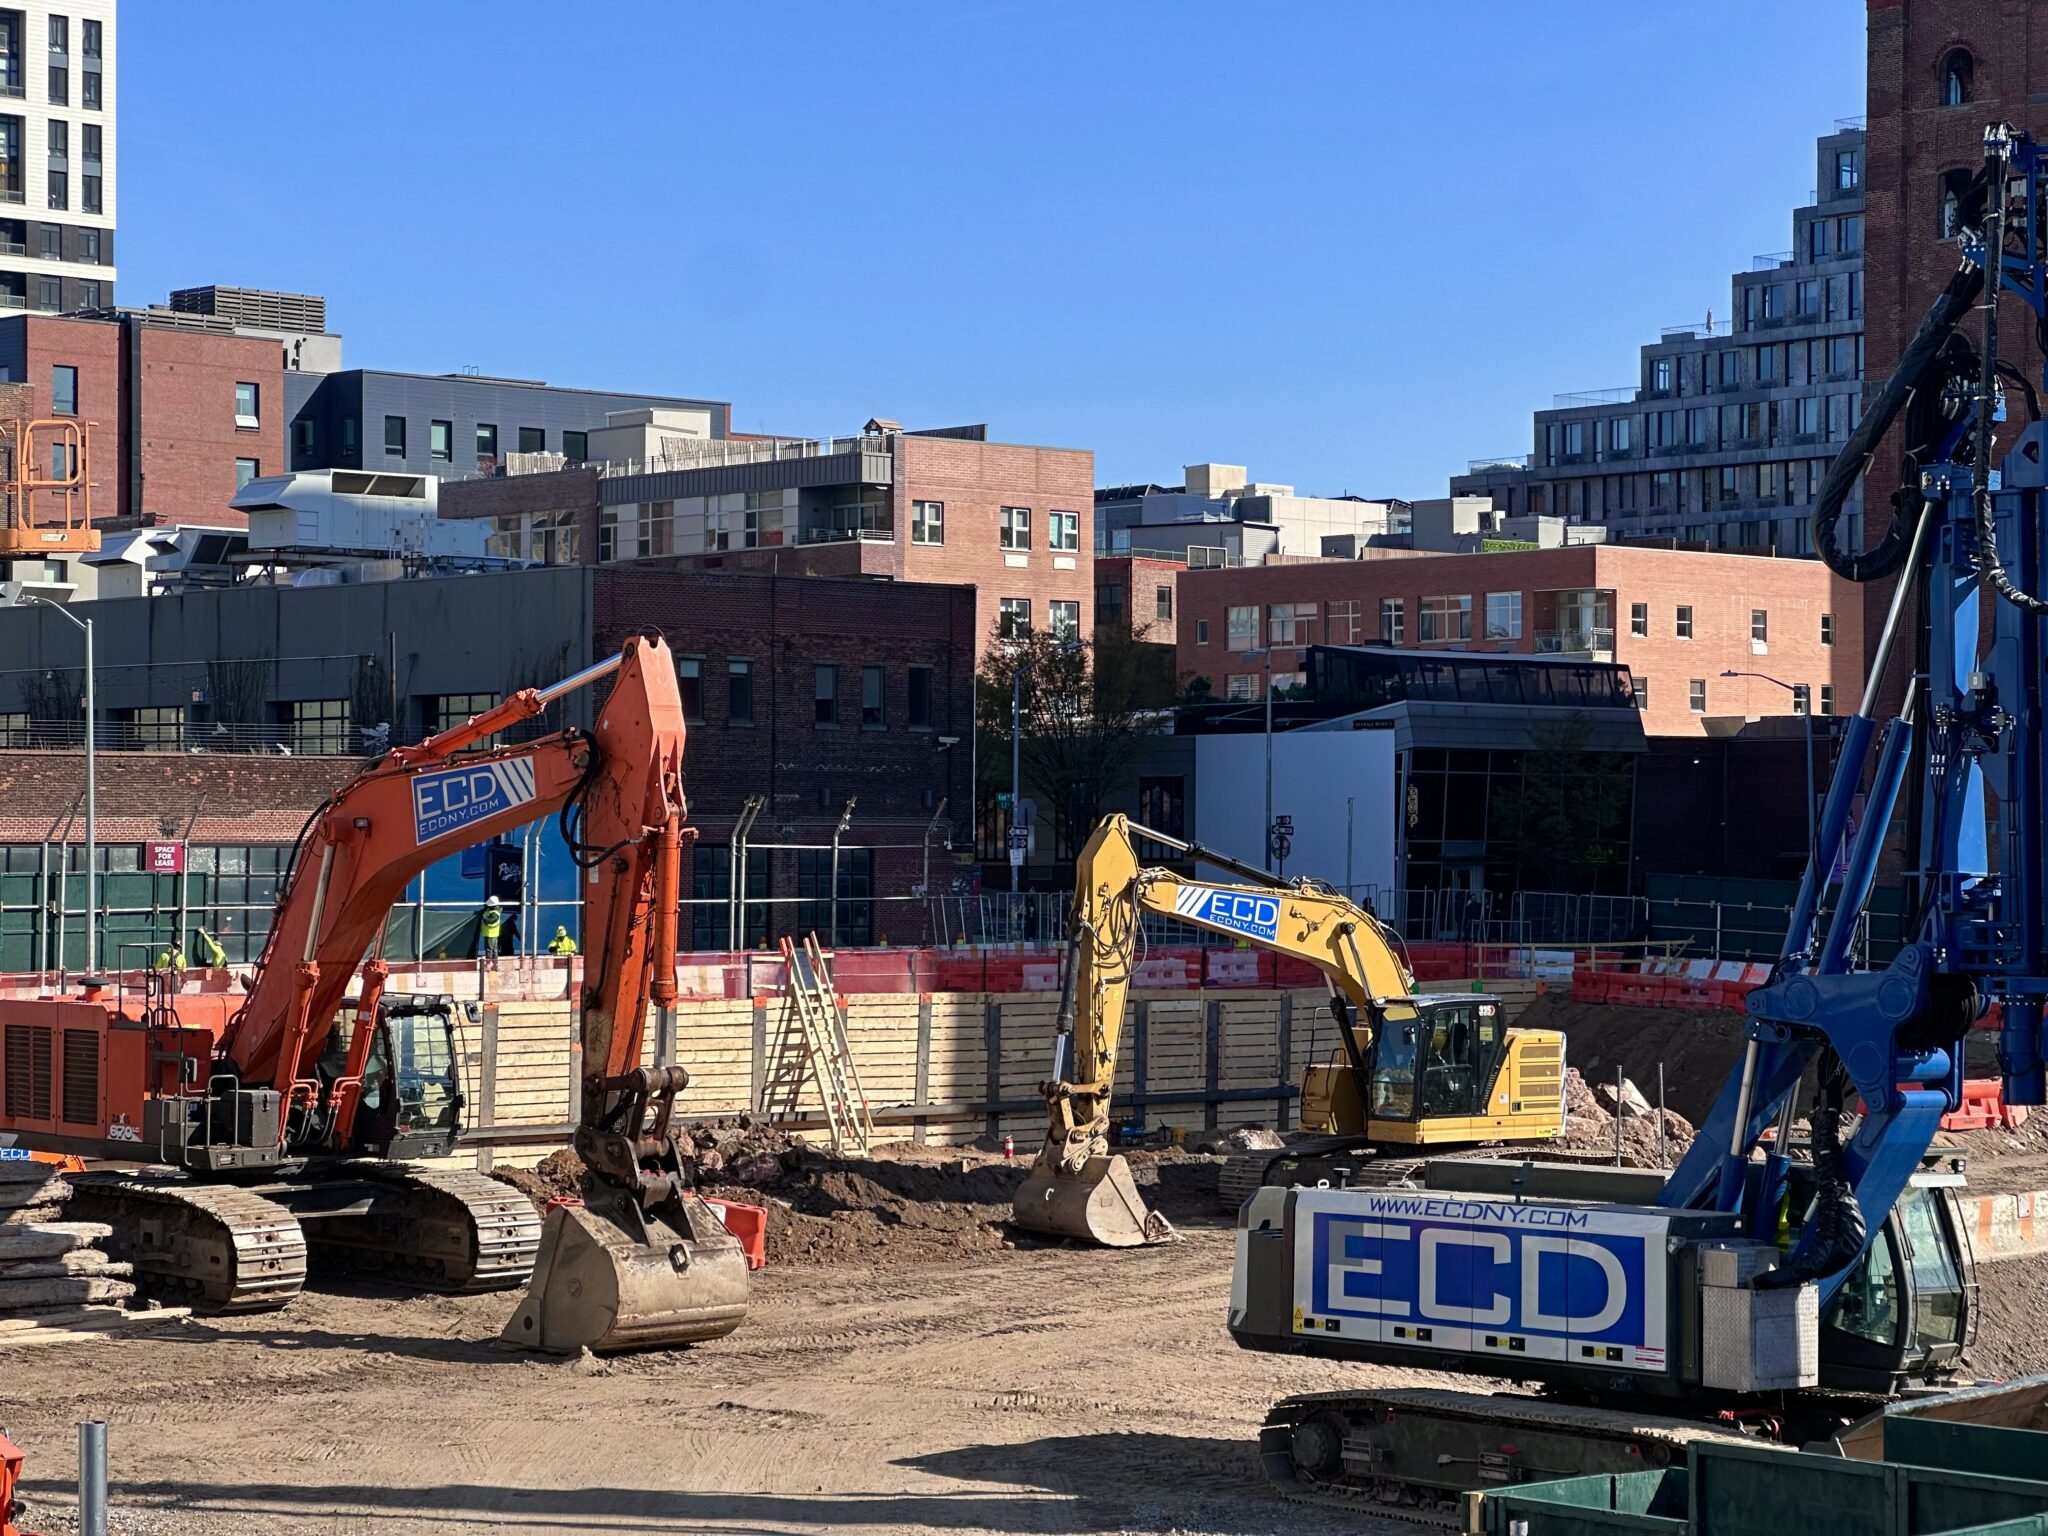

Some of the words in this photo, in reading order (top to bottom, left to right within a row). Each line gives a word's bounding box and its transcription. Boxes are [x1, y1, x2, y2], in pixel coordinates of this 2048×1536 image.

[416, 772, 497, 820] ECD
[420, 799, 499, 835] ECDNY.COM
[1209, 914, 1275, 938] ECDNY.COM
[1211, 894, 1277, 926] ECD
[110, 1125, 132, 1140] 670
[1370, 1198, 1588, 1227] WWW.ECDNY.COM
[1328, 1220, 1627, 1333] ECD
